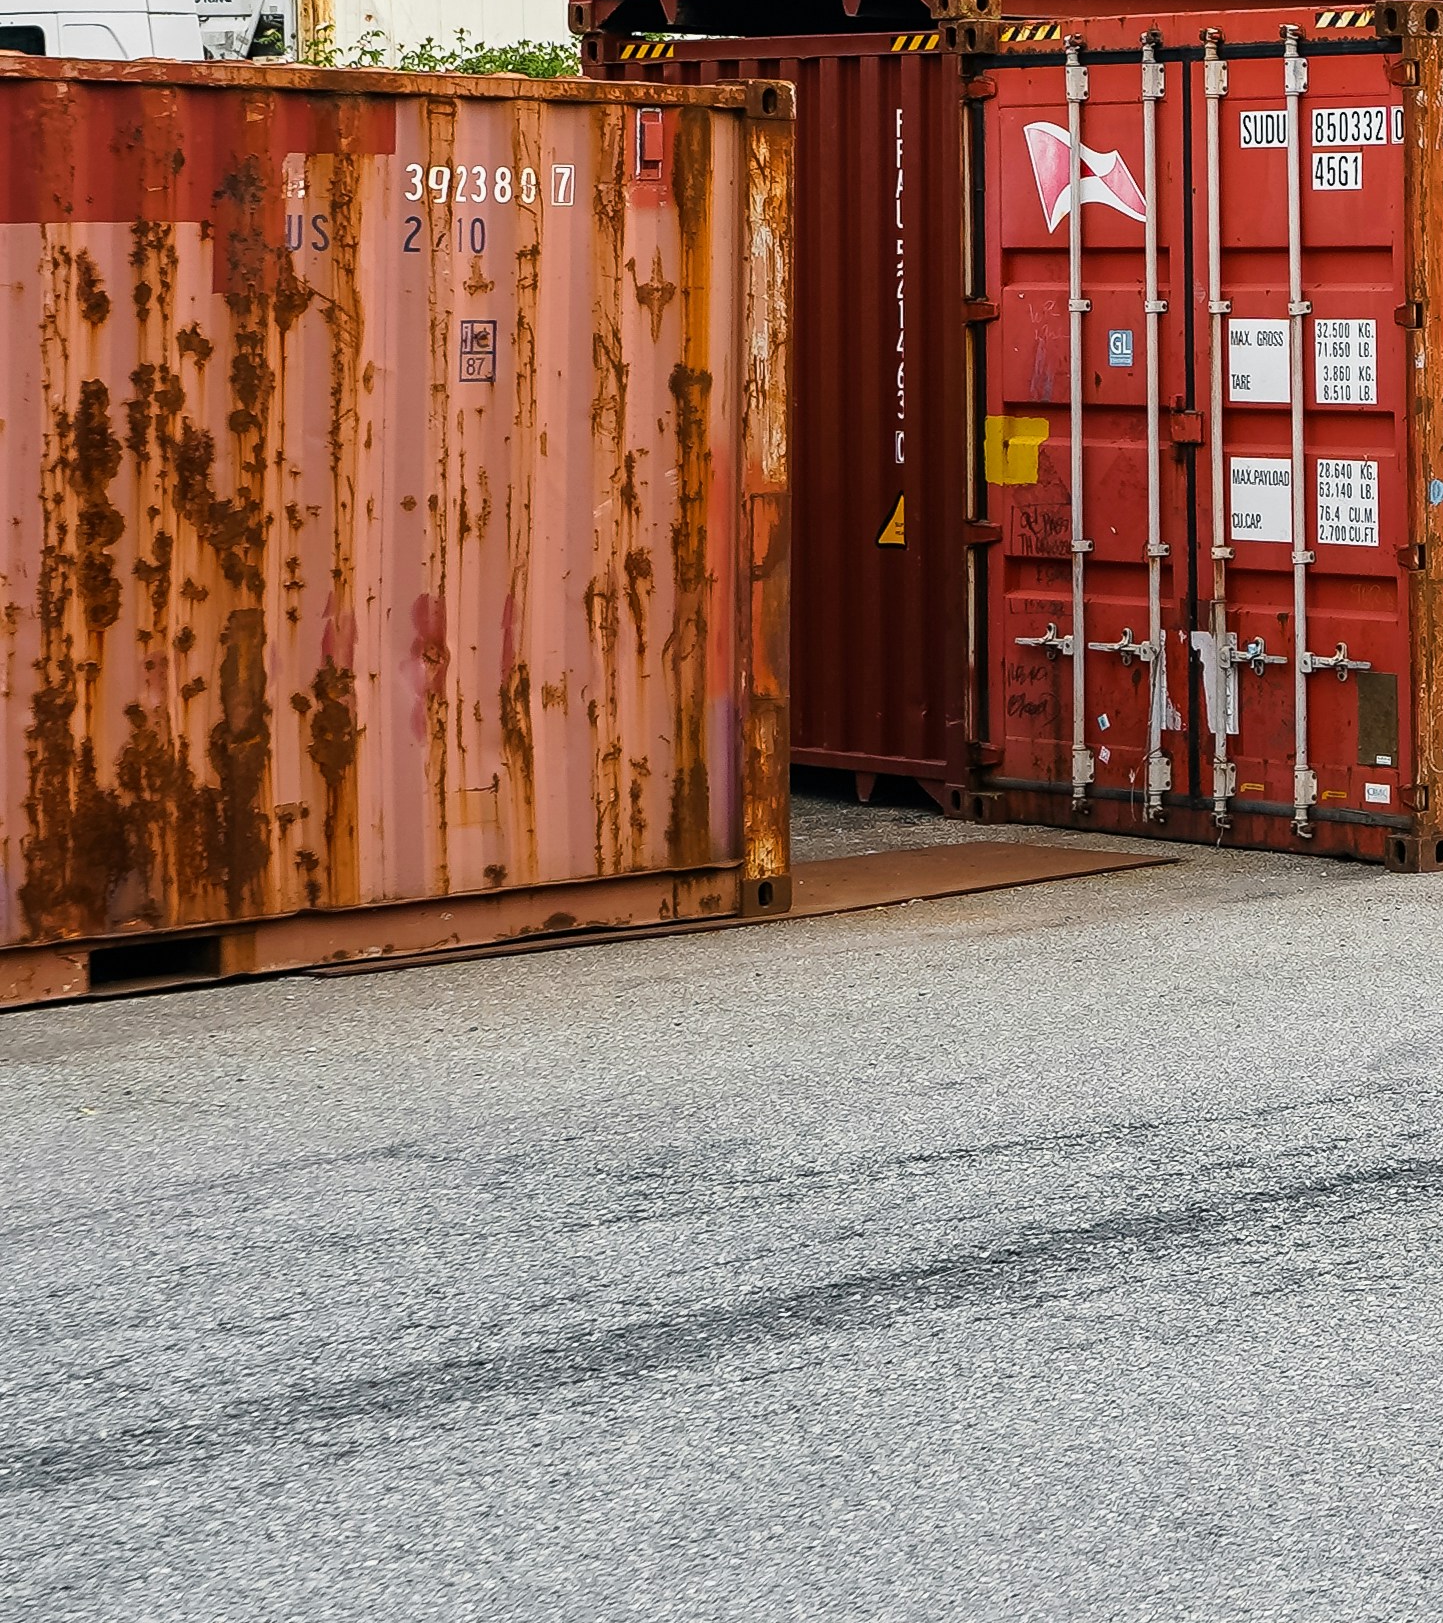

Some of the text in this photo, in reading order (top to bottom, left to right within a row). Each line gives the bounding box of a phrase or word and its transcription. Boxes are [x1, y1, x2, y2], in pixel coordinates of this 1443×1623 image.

[1242, 109, 1404, 145] SUDU 850332 0
[1315, 156, 1359, 187] 45G1
[404, 164, 537, 204] 392380
[1231, 330, 1284, 346] MAX. GROSS
[1317, 322, 1374, 338] 32.500 KG.
[1110, 333, 1132, 354] GL
[1317, 342, 1373, 358] 71.650 LB.
[465, 357, 486, 376] 87
[1323, 365, 1375, 382] 3.860 KG.
[1231, 374, 1251, 391] TARE
[1323, 384, 1374, 401] 8.510 LB.
[1232, 469, 1290, 487] MAX.PAYLOAD
[1319, 462, 1376, 481] 28.640 KG.
[1319, 482, 1375, 500] 63.140 LB.
[1232, 513, 1263, 530] CU.CAP.
[1319, 505, 1376, 524] 76.4 CU.M.
[1319, 524, 1377, 544] 2.700 CU.FT.
